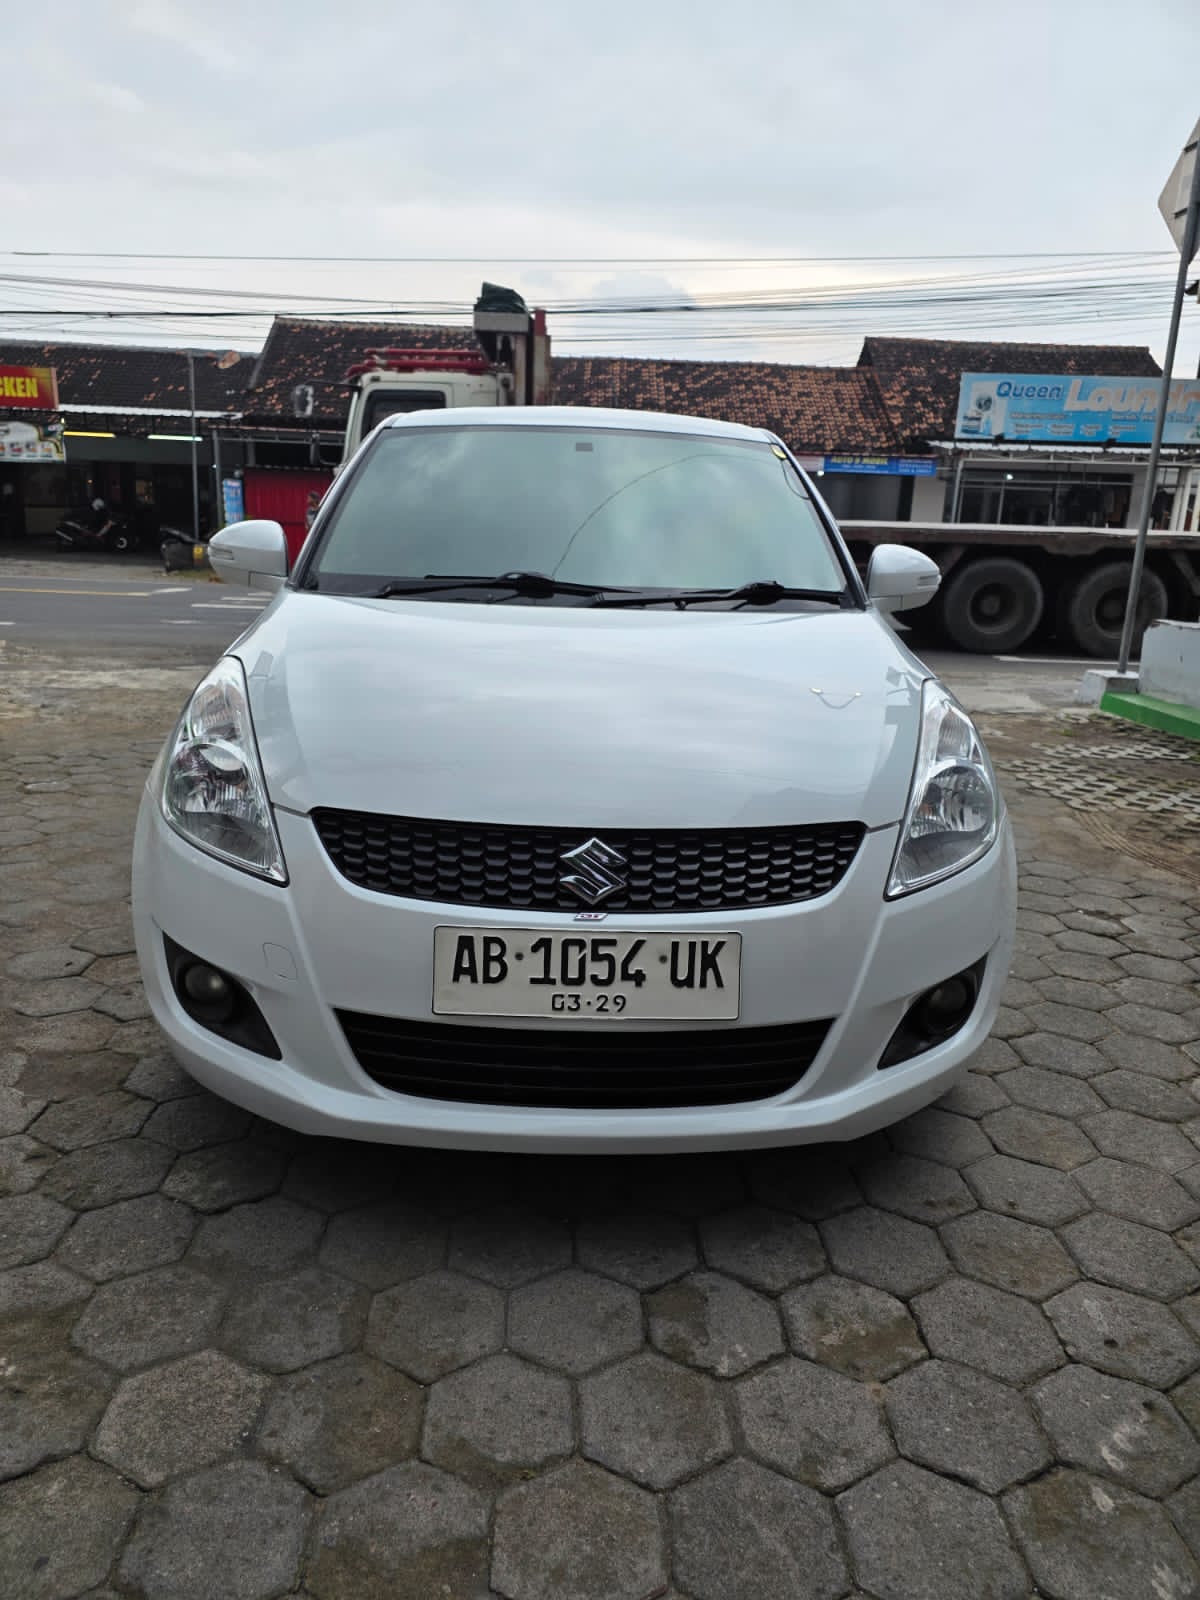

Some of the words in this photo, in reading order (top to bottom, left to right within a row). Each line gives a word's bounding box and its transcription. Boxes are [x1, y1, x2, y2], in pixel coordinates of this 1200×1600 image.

[996, 381, 1063, 400] Queen
[452, 935, 508, 984] AB
[529, 937, 647, 987] 1054
[670, 940, 727, 988] UK
